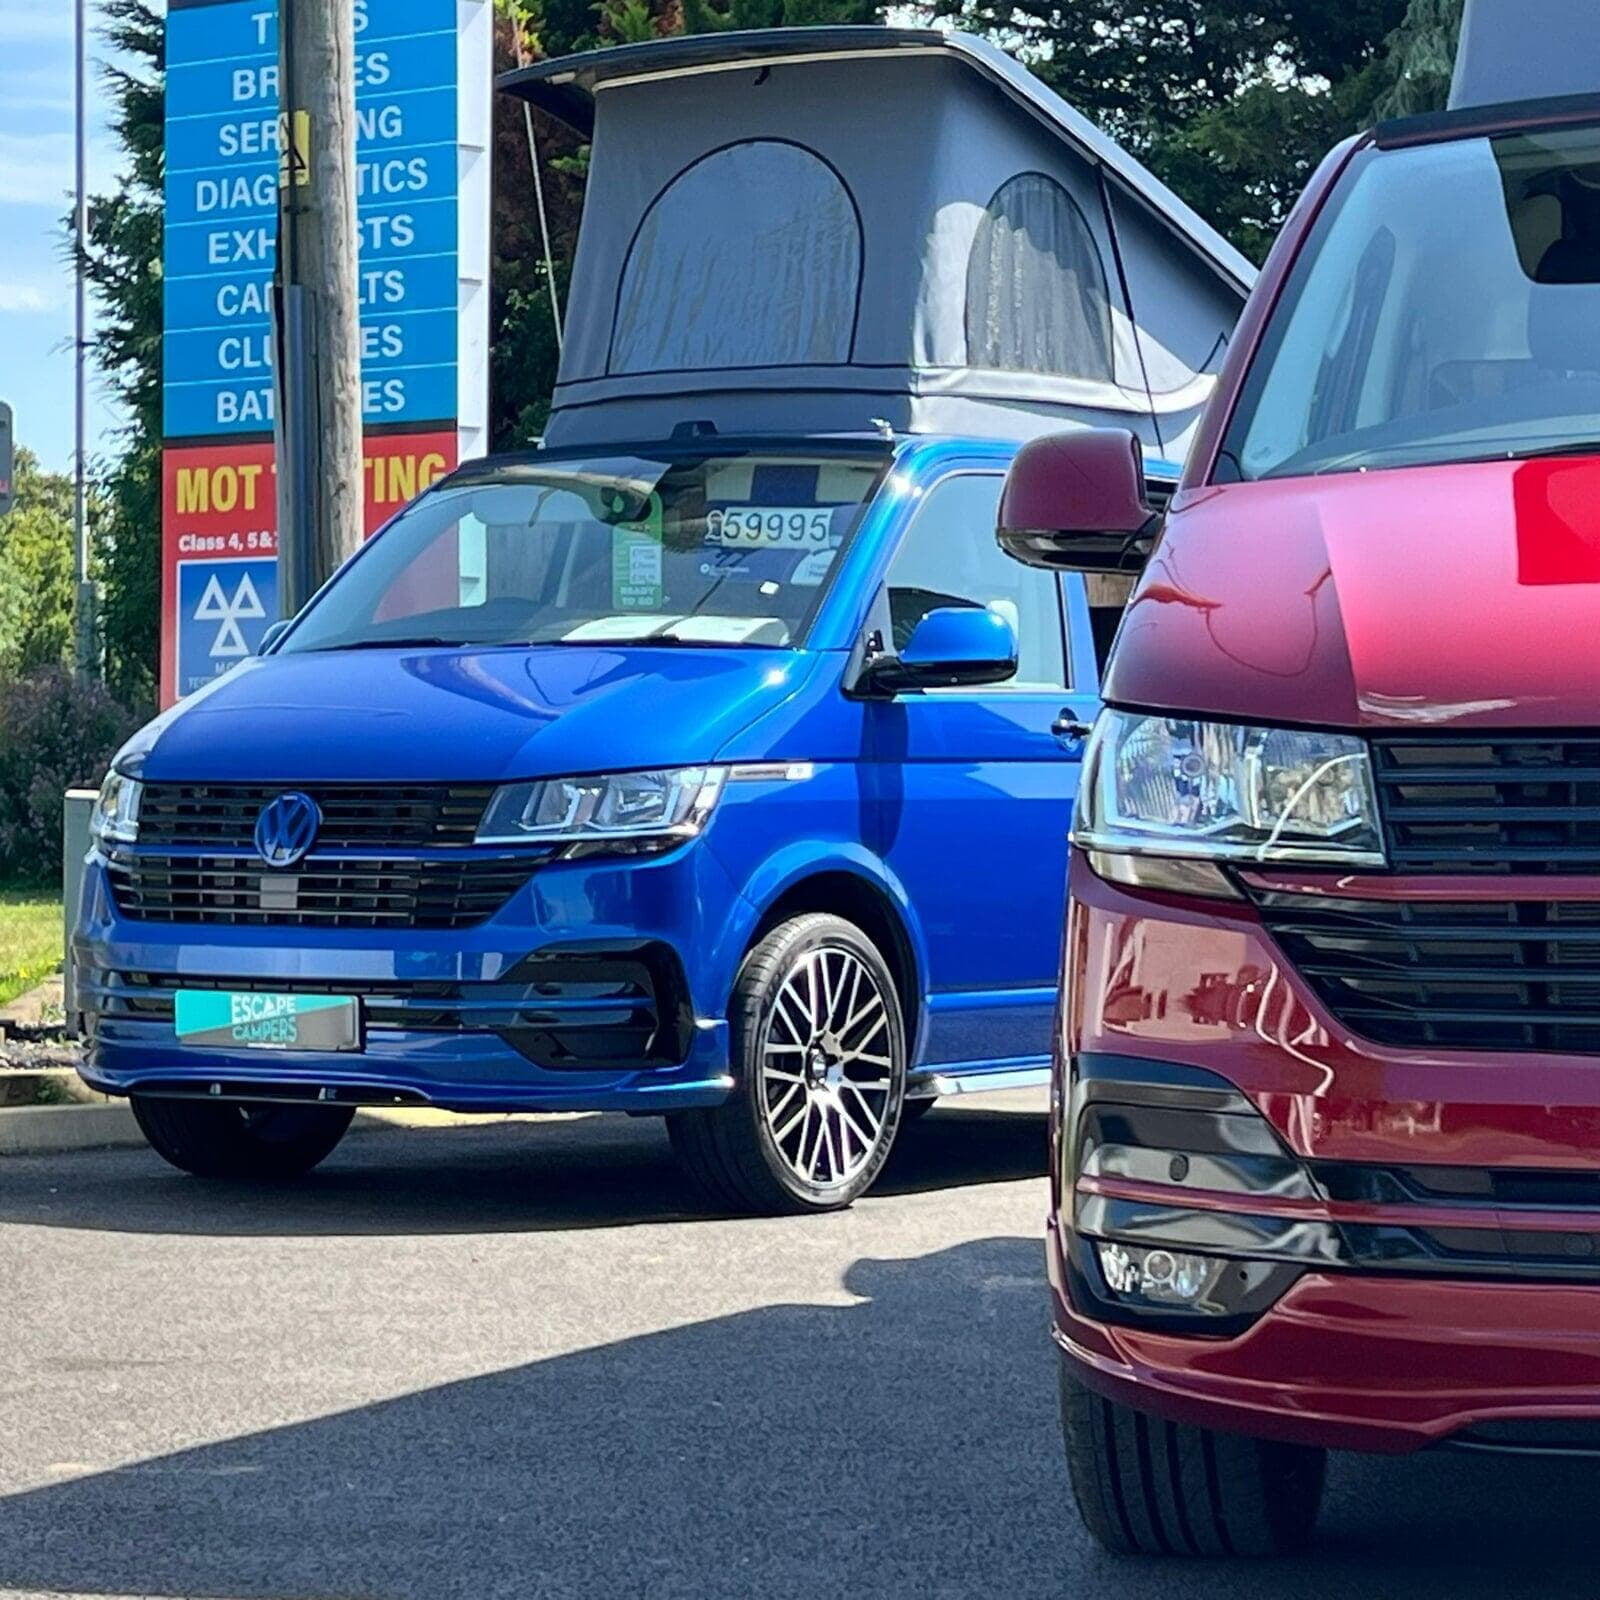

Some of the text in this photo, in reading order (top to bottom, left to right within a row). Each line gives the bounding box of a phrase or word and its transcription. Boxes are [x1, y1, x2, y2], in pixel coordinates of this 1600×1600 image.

[196, 157, 428, 212] DIAGTICS
[176, 464, 263, 515] MOT
[178, 533, 225, 552] Class
[231, 995, 296, 1024] ESCAPE
[232, 1014, 297, 1042] CAMPERS
